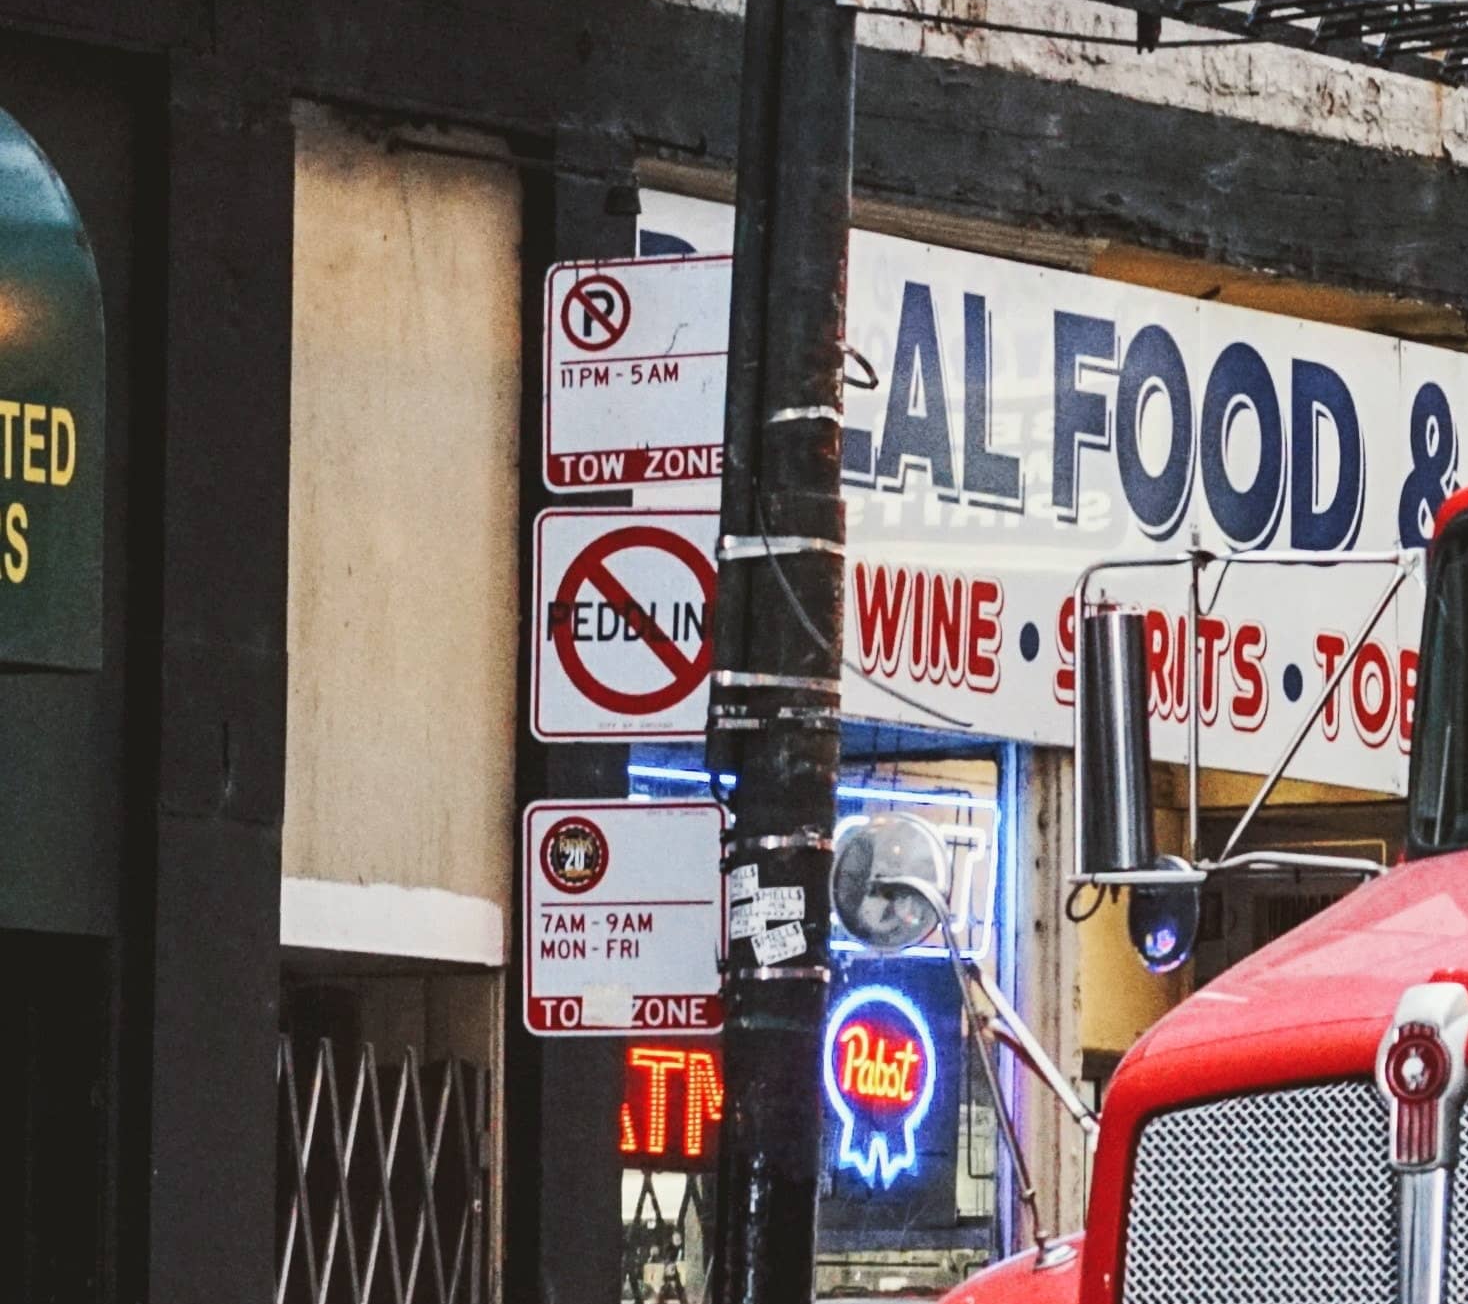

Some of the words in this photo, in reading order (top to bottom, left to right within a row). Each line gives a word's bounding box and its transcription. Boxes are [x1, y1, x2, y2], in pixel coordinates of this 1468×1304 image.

[0, 401, 77, 486] TED
[1053, 309, 1366, 554] FOOD
[1399, 381, 1463, 551] &
[559, 452, 625, 483] TOW
[643, 446, 724, 480] ZONE
[547, 601, 712, 642] PEDDLIN
[853, 562, 1003, 694] WINE
[540, 912, 586, 934] 7AM
[605, 911, 653, 933] 9AM
[540, 939, 587, 960] MON
[605, 938, 640, 959] FRI
[540, 1000, 582, 1028] TO
[630, 997, 708, 1026] ZONE
[837, 1025, 921, 1103] Pabst
